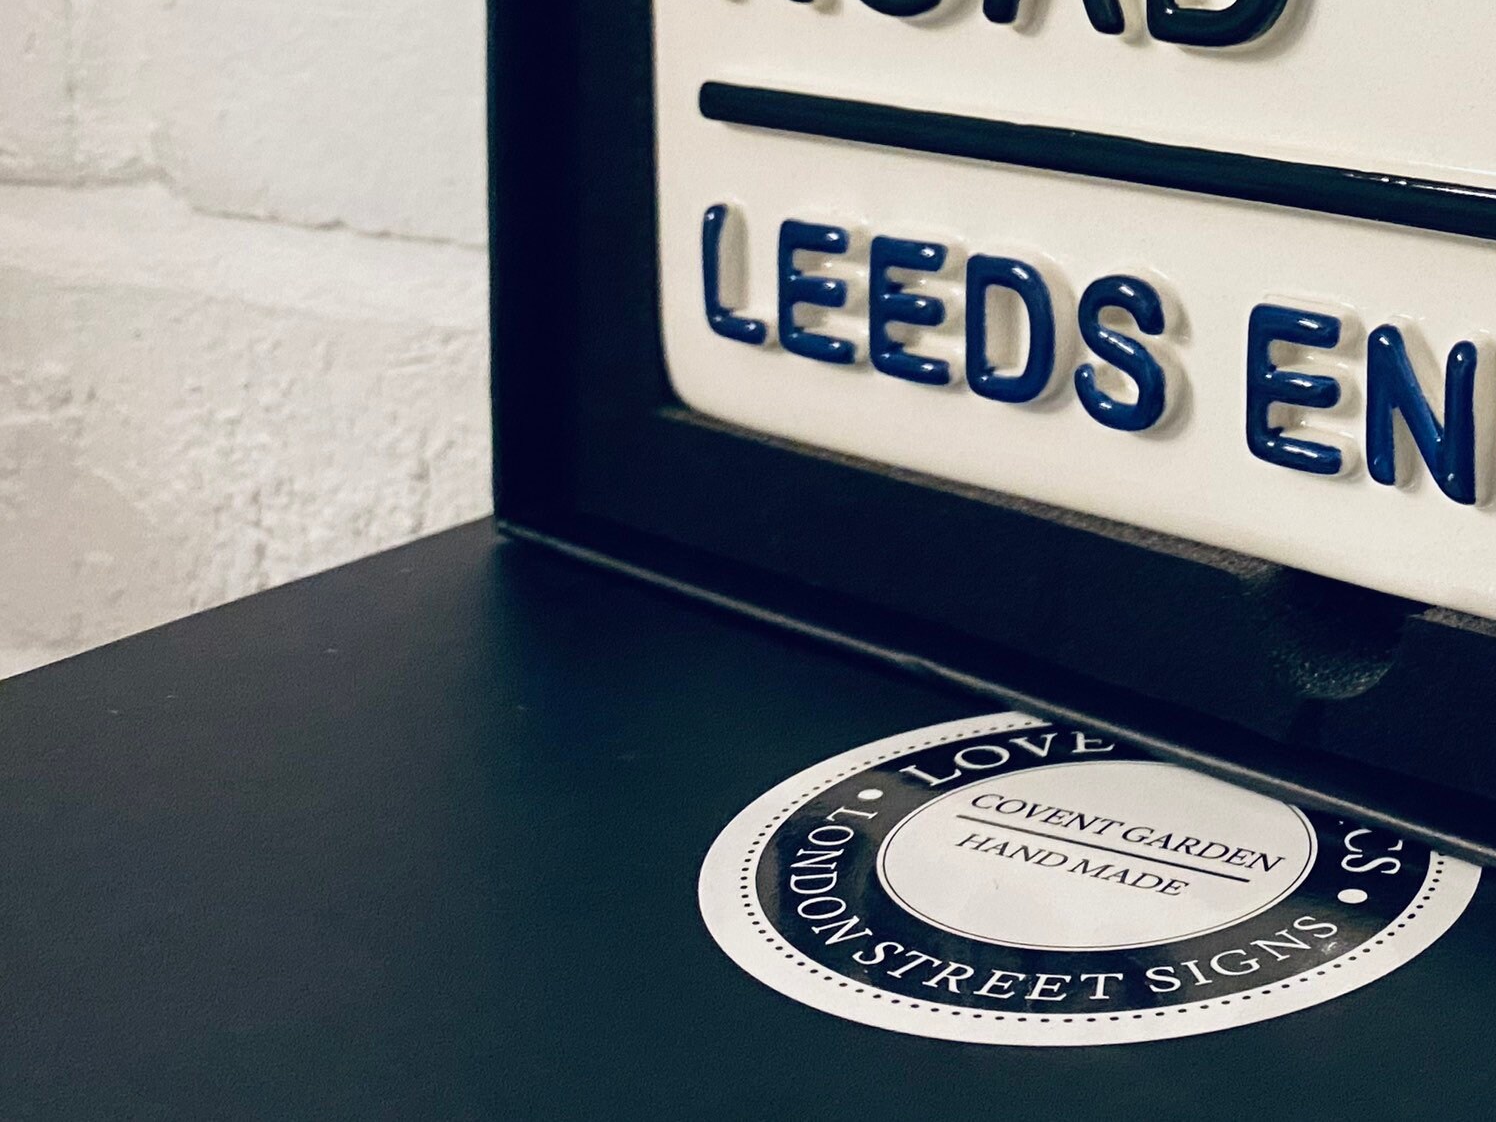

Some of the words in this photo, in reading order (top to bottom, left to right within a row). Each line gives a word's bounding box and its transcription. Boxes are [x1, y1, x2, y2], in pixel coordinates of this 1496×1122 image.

[701, 203, 1165, 431] LEEDS
[954, 832, 1070, 869] HAND
[1070, 857, 1191, 897] MADE
[970, 792, 1125, 836] COVENT
[1121, 825, 1287, 873] GARDEN
[789, 806, 879, 946] LONDON
[851, 940, 1124, 1000] STREET
[1143, 914, 1339, 993] SIGNS
